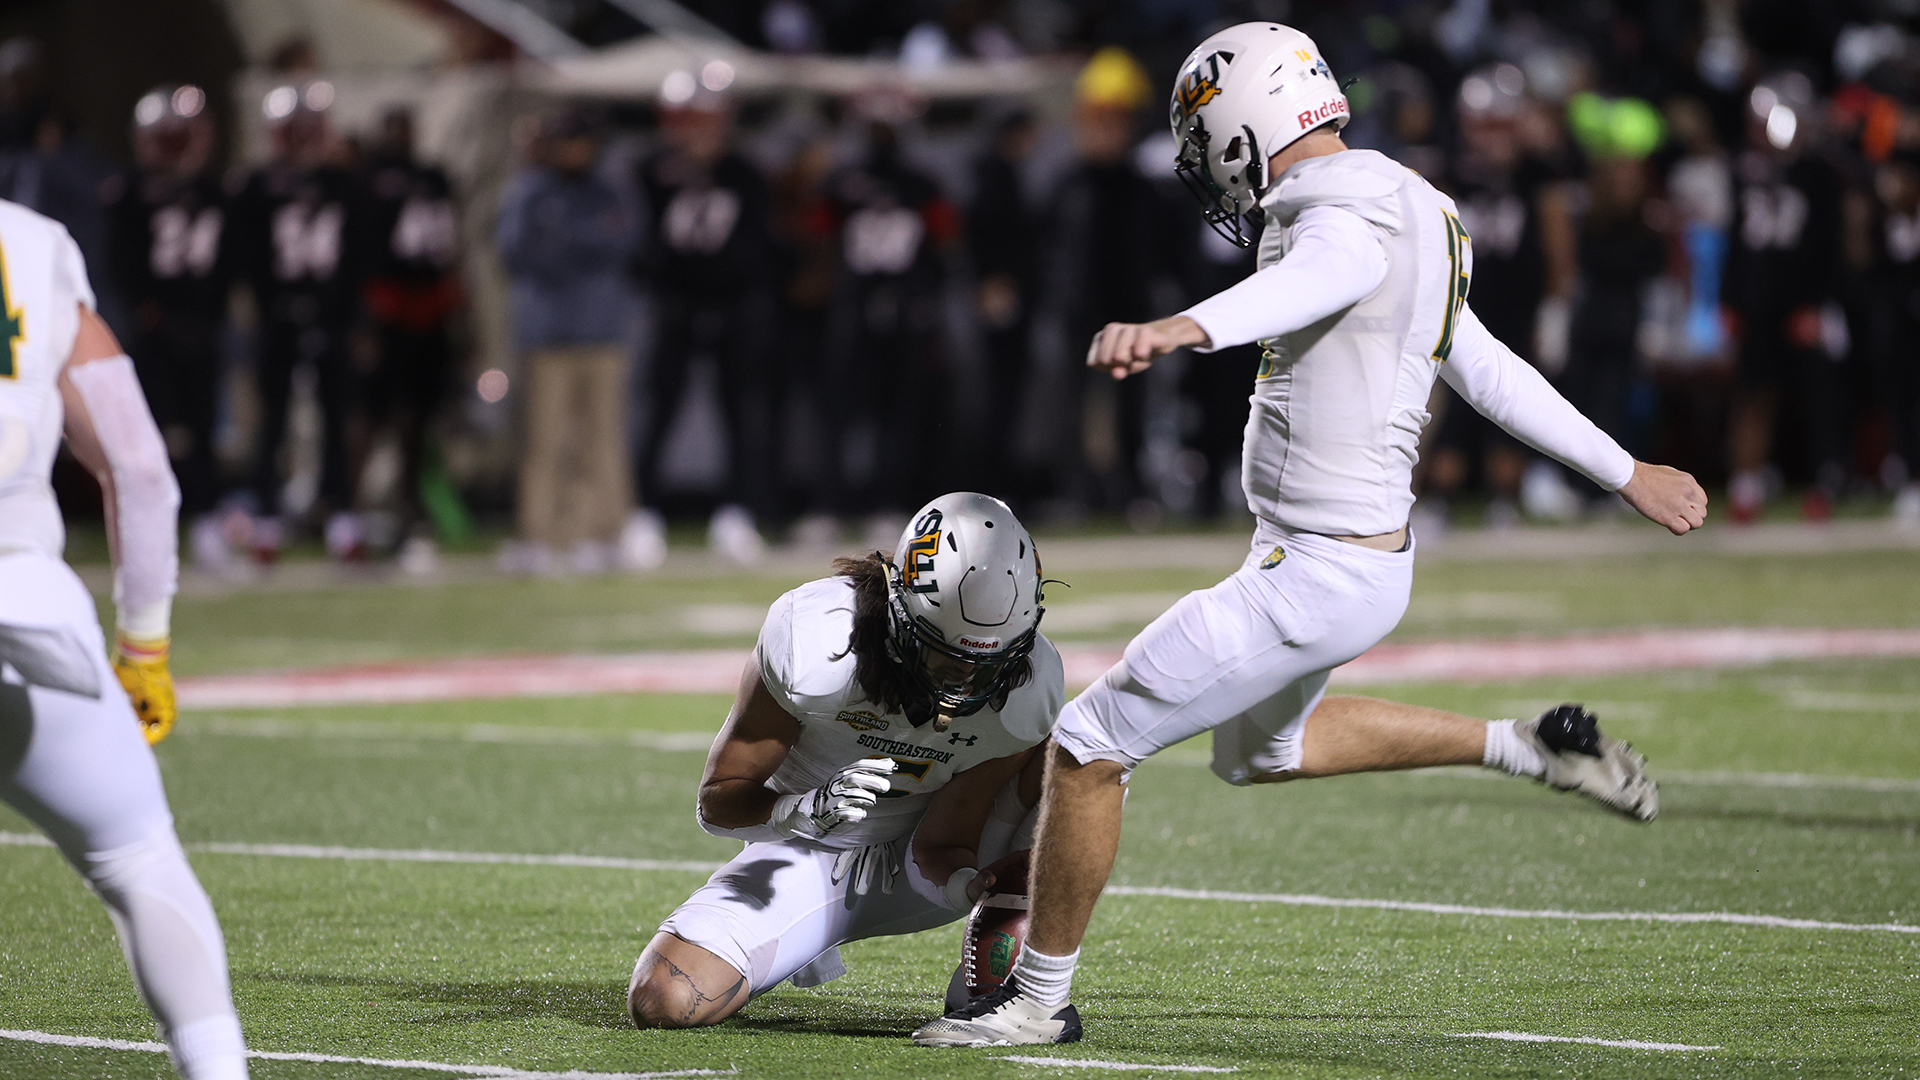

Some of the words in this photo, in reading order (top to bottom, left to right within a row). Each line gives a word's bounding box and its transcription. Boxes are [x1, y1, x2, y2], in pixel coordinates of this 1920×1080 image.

[1294, 48, 1312, 63] 16
[902, 512, 944, 594] SLU
[959, 638, 999, 650] Riddell
[836, 711, 889, 731] SOUTHLAND
[856, 733, 955, 765] SOUTHEASTERN
